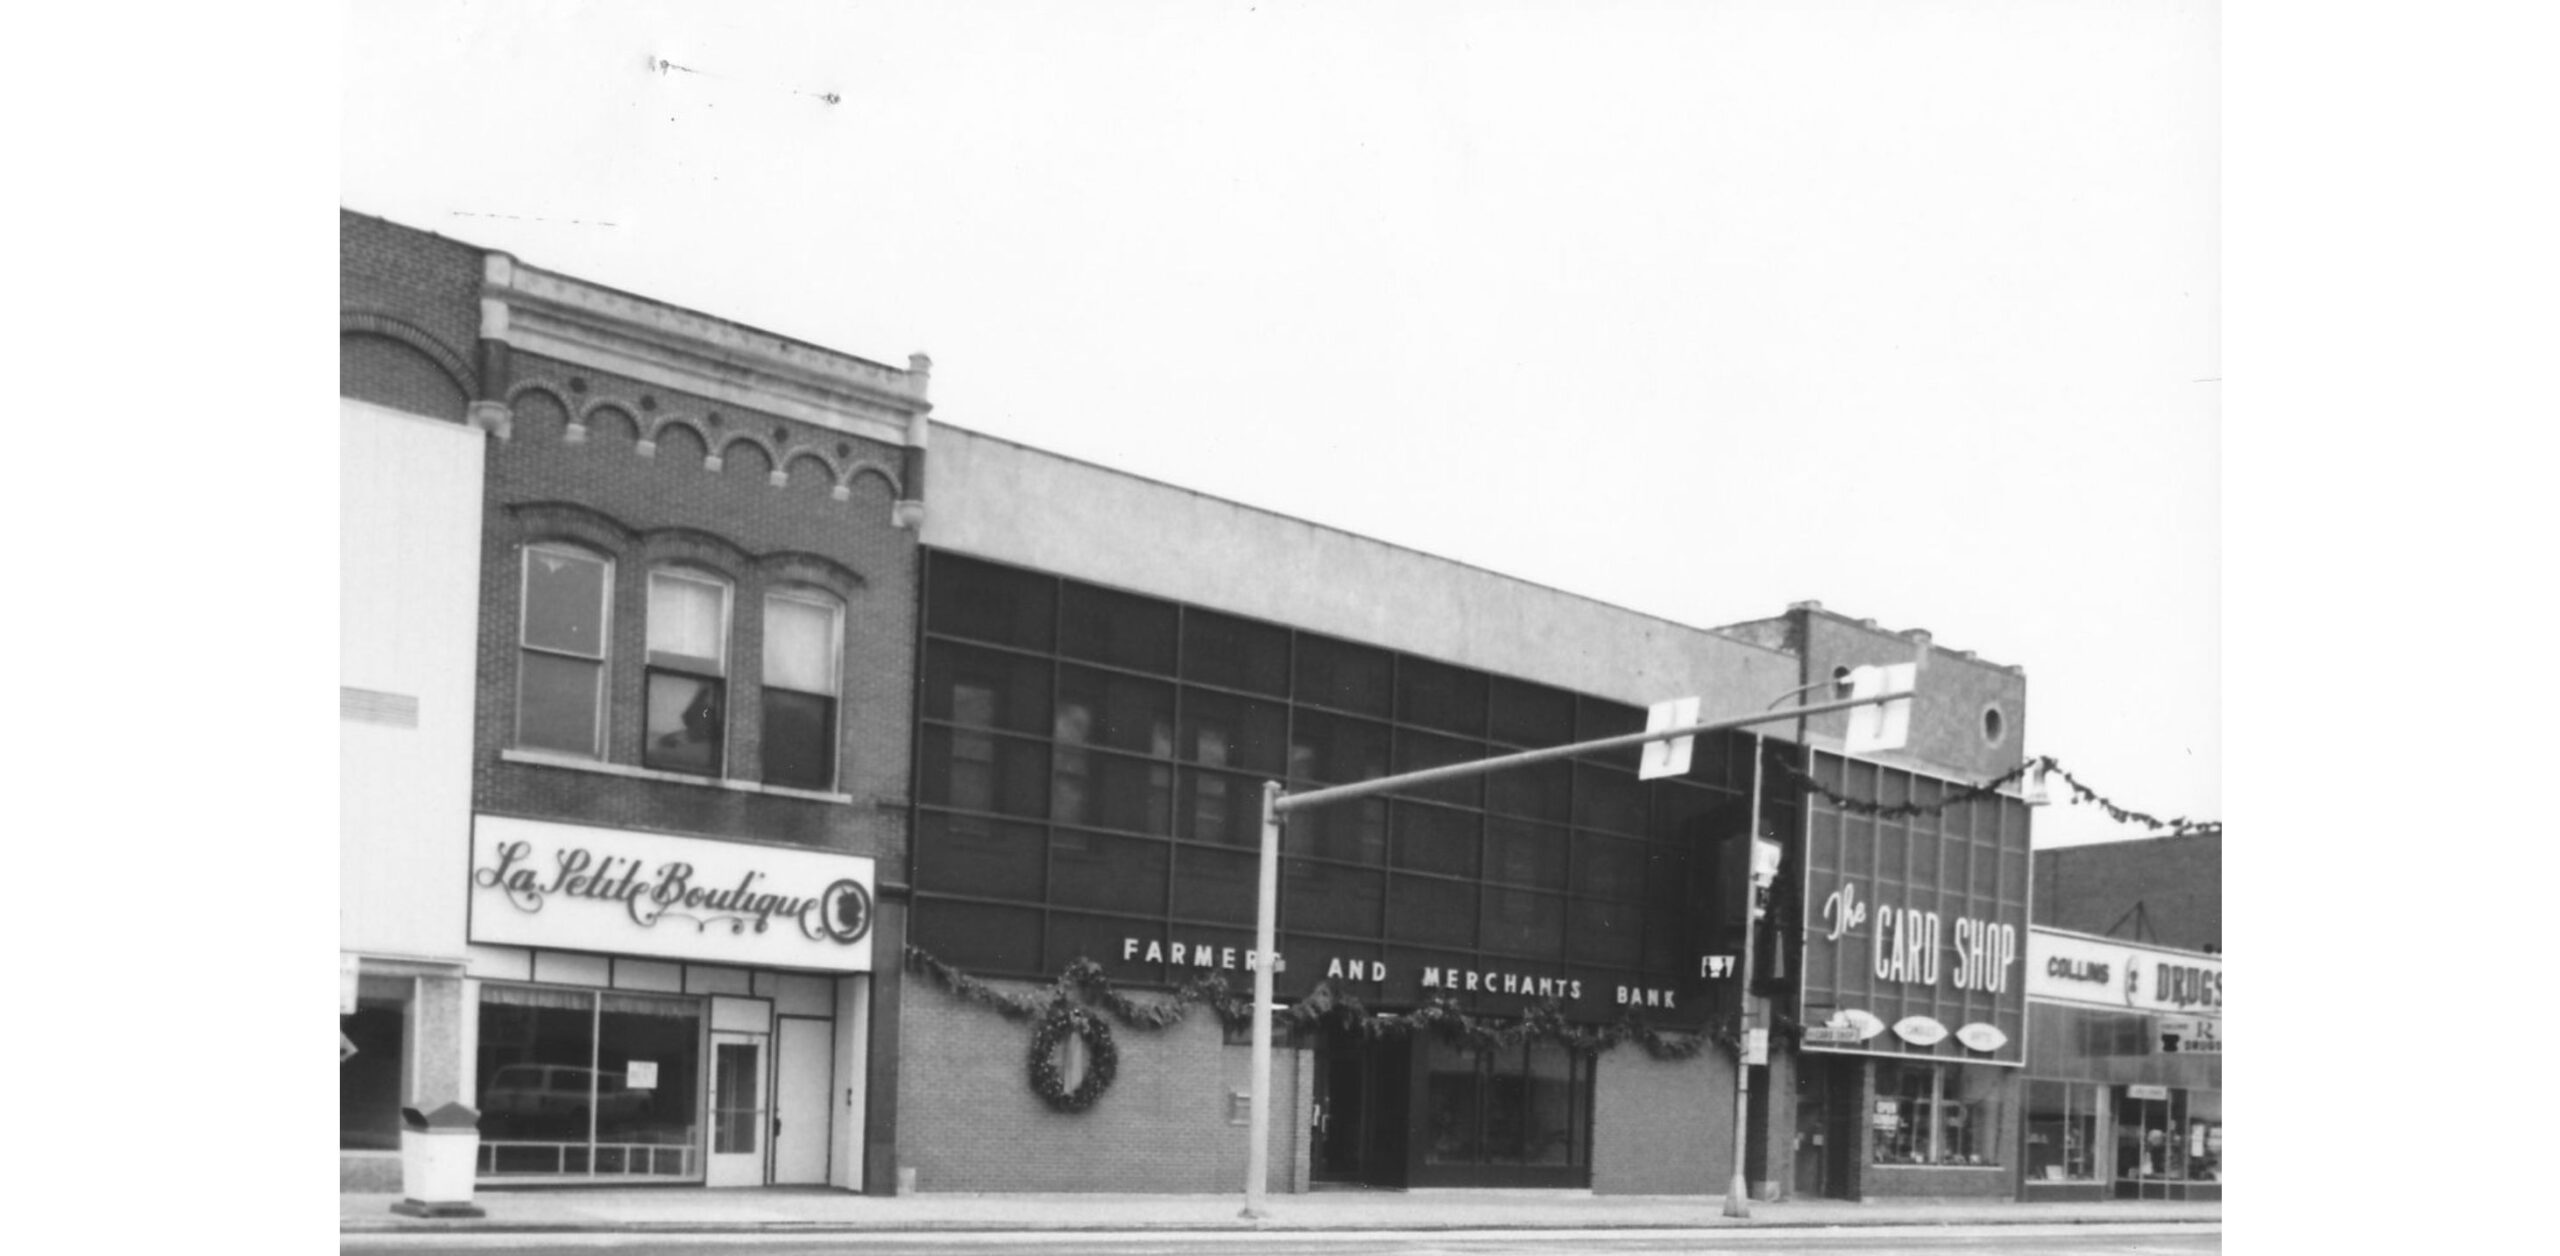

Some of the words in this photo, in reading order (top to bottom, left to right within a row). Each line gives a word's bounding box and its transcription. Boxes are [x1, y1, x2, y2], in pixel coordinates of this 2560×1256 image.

[475, 841, 543, 913] La
[539, 848, 660, 927] Petite
[650, 862, 826, 941] Boutique
[1824, 883, 1866, 941] The
[1875, 905, 1940, 985] CARD
[1953, 917, 2016, 993] SHOP
[2047, 956, 2109, 984] COLLINS
[1327, 957, 1386, 982] AND
[1422, 967, 1582, 999] MERCHANTS
[1616, 986, 1676, 1008] BANK
